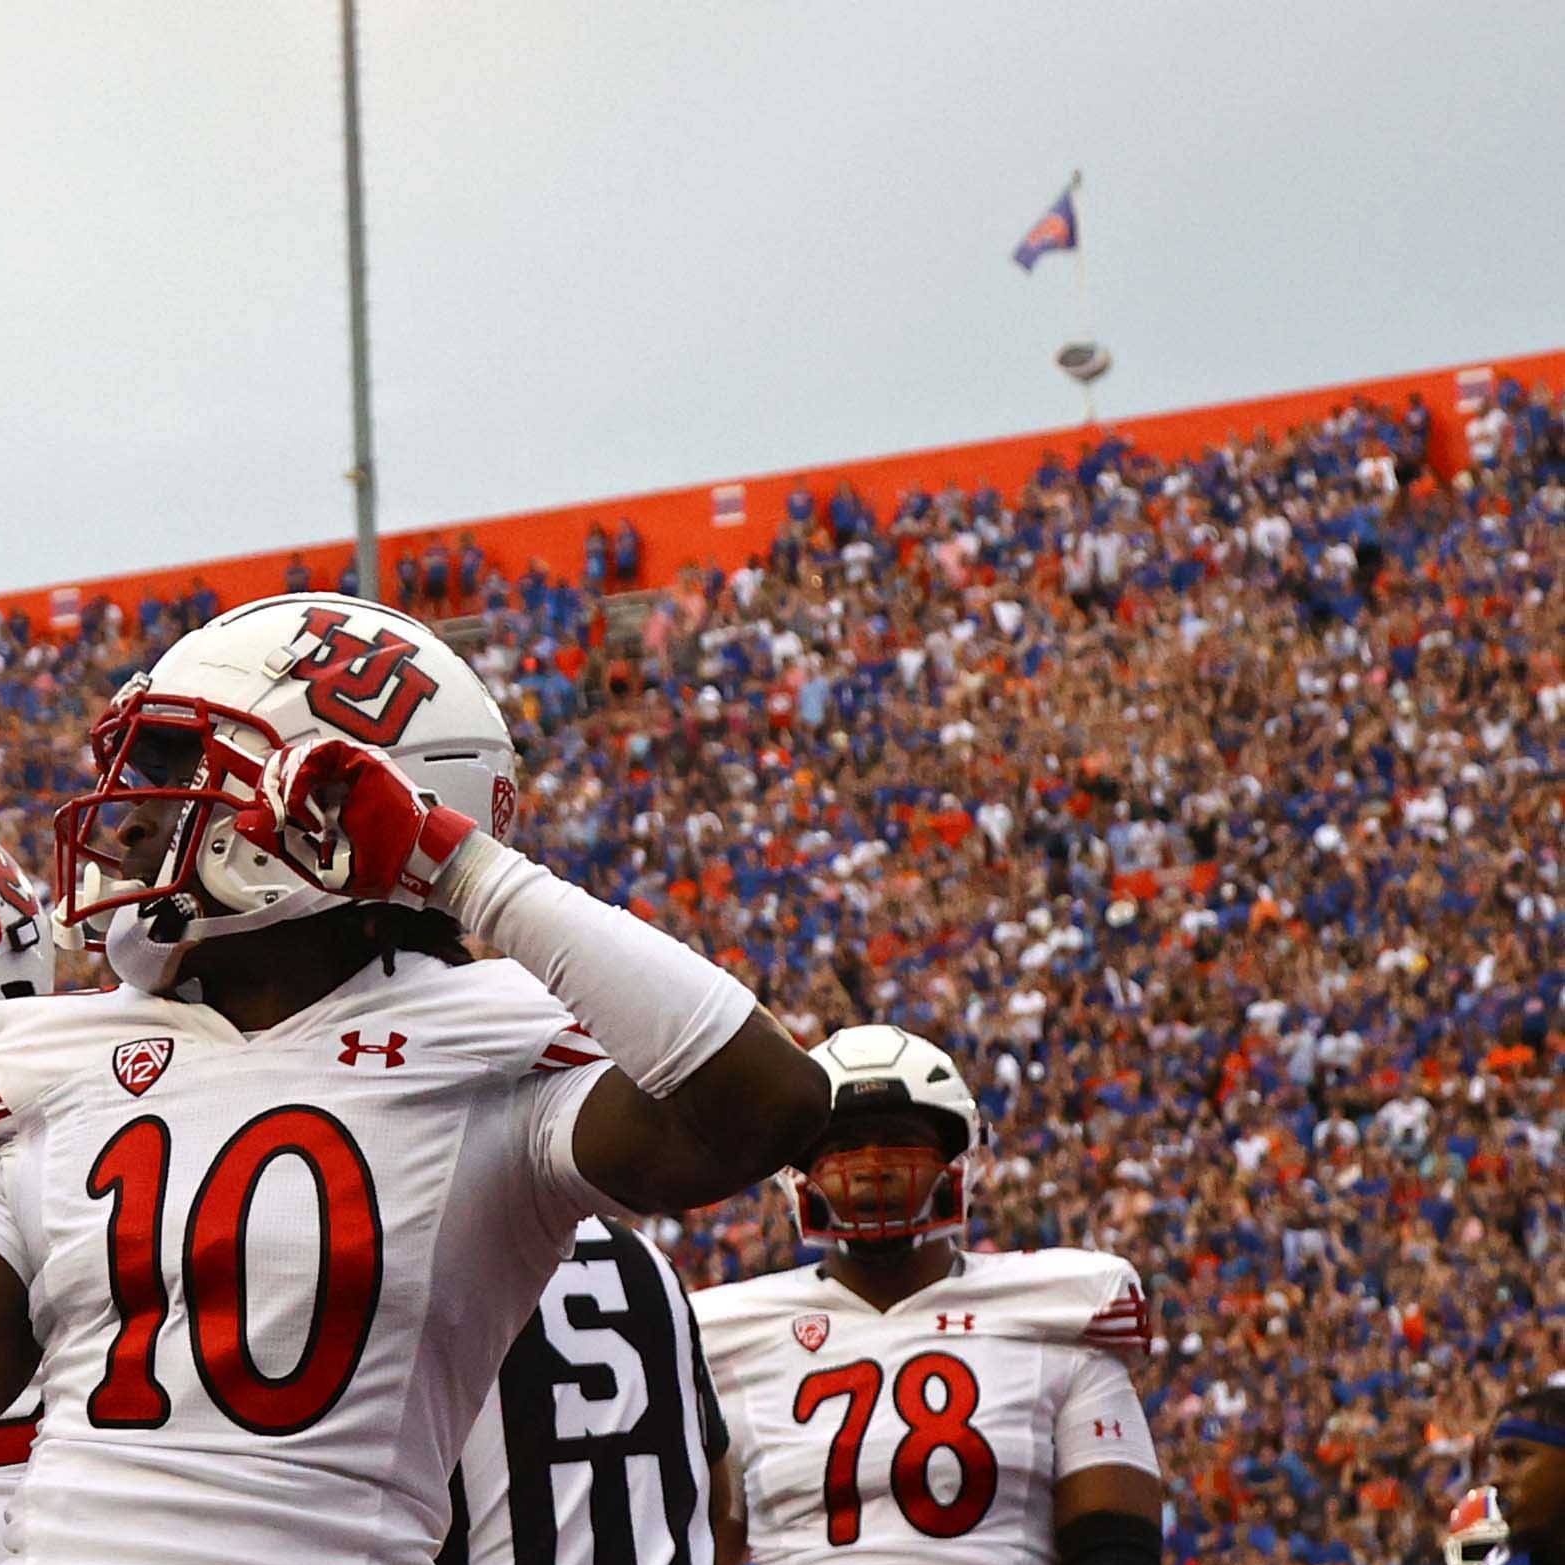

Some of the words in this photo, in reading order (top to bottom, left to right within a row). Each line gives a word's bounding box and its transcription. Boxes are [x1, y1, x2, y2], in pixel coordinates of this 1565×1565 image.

[116, 1040, 169, 1076] PAC
[126, 1061, 153, 1085] 12
[85, 1104, 383, 1436] 10
[540, 1258, 649, 1440] S
[793, 1350, 998, 1546] 78
